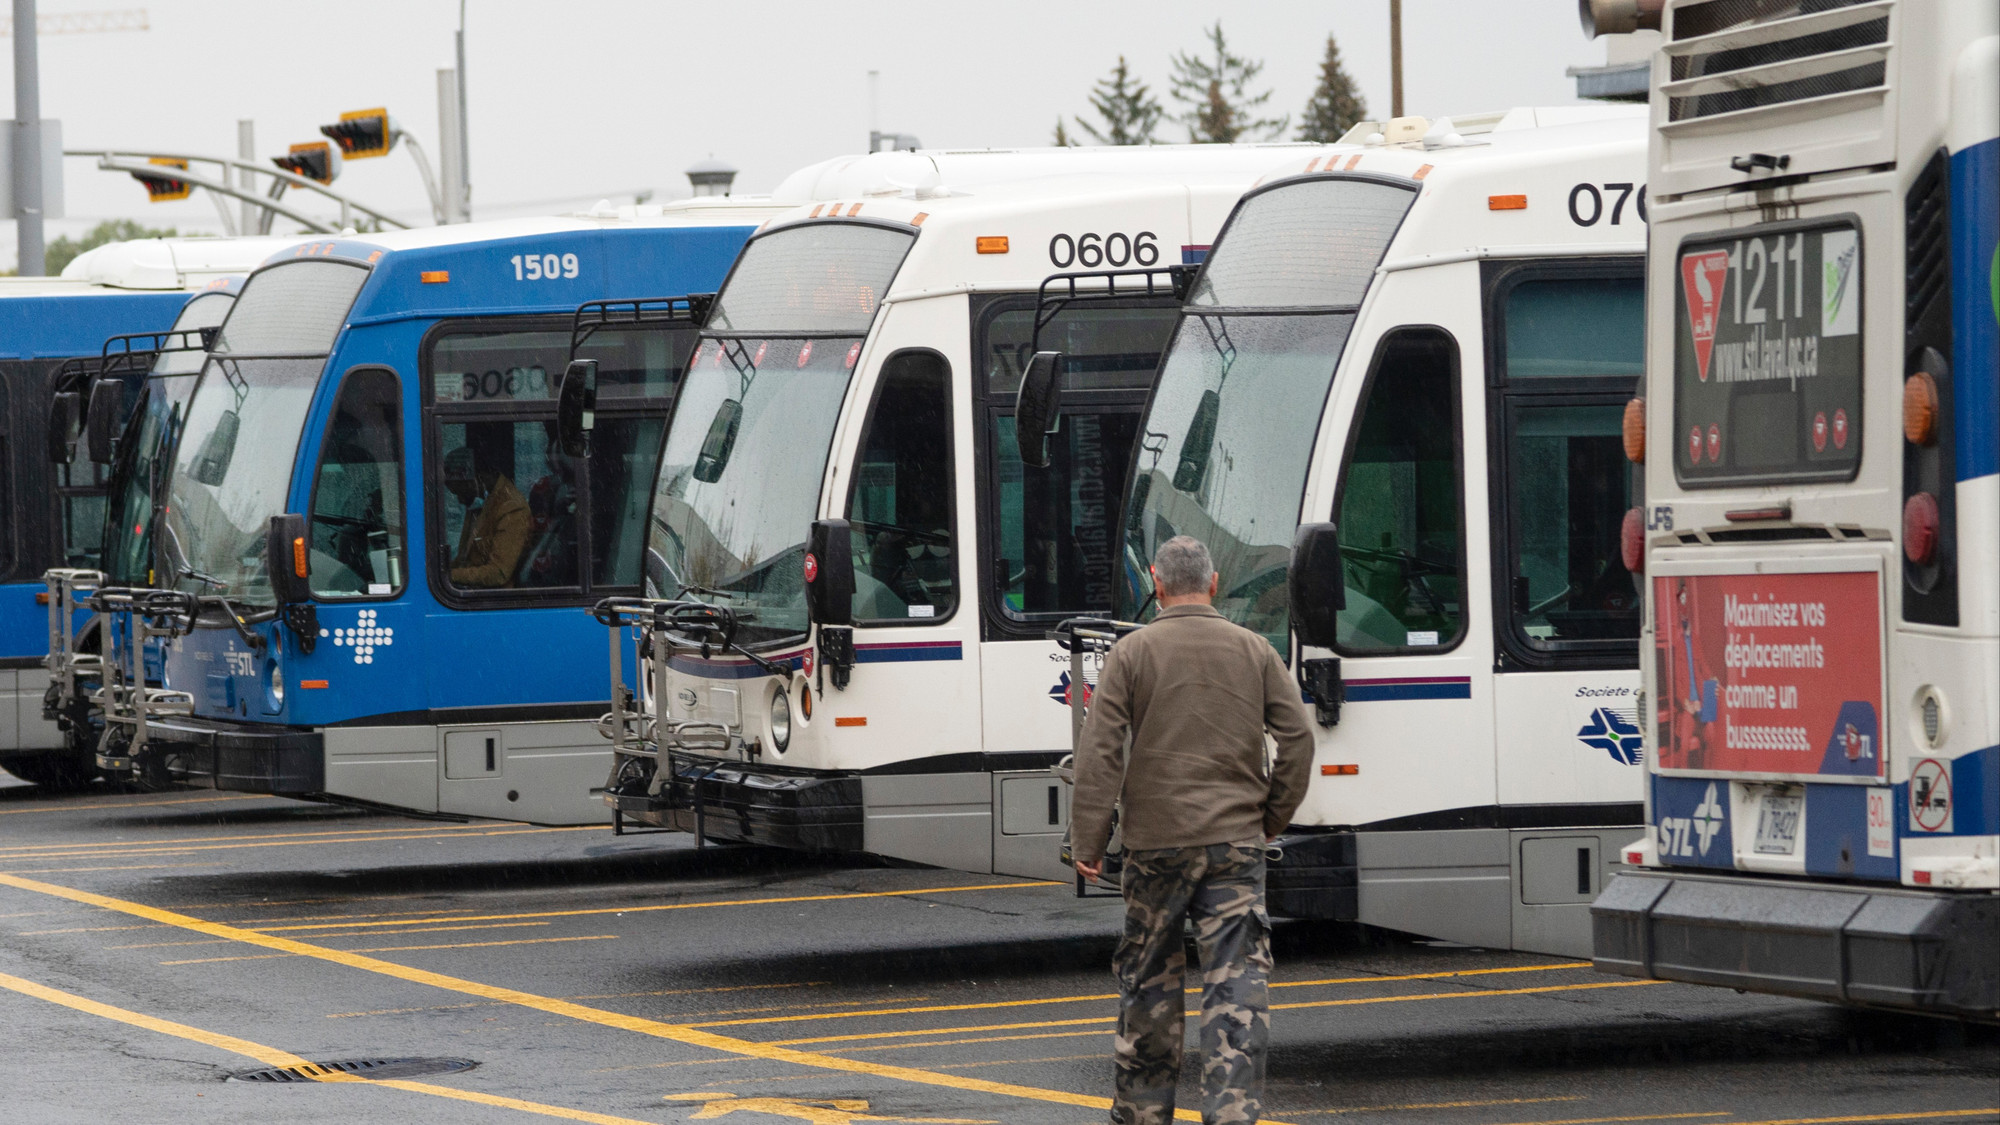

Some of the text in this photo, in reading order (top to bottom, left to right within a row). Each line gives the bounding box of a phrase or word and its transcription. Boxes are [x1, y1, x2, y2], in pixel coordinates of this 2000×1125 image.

[1049, 231, 1159, 268] 0606
[510, 253, 579, 280] 1509
[1728, 233, 1803, 324] 1211
[1647, 507, 1673, 530] LFS
[1724, 593, 1826, 627] Maximisez vos
[238, 652, 256, 677] STL
[1049, 653, 1092, 663] Soce
[1725, 633, 1824, 678] déplacements
[1575, 686, 1630, 697] Societe
[1725, 684, 1798, 709] comme un
[1658, 816, 1693, 857] STL
